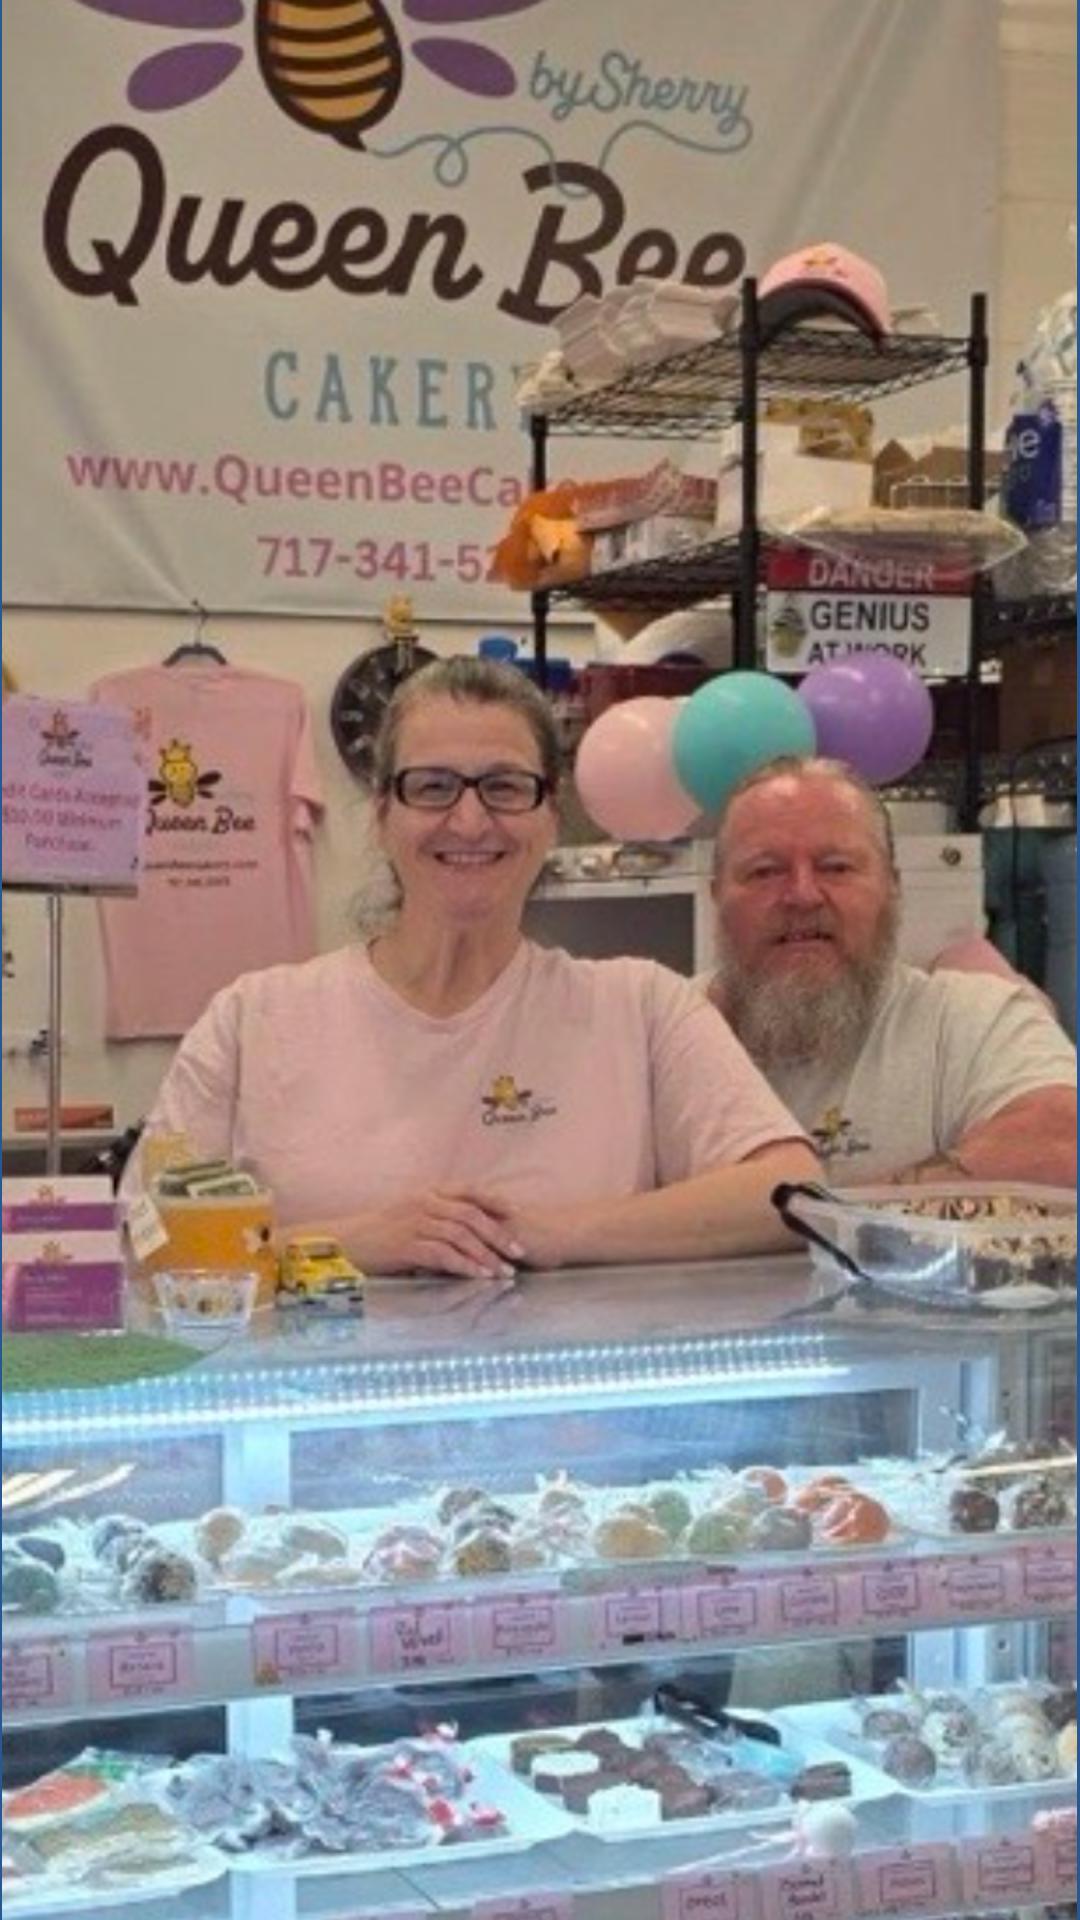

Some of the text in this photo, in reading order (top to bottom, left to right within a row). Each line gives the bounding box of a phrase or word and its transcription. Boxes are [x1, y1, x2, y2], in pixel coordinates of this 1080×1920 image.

[530, 50, 749, 134] by Sherry
[42, 124, 746, 325] Queen Bee
[265, 350, 531, 432] CAKER
[808, 557, 934, 590] DANGER
[811, 600, 930, 632] GENIUS
